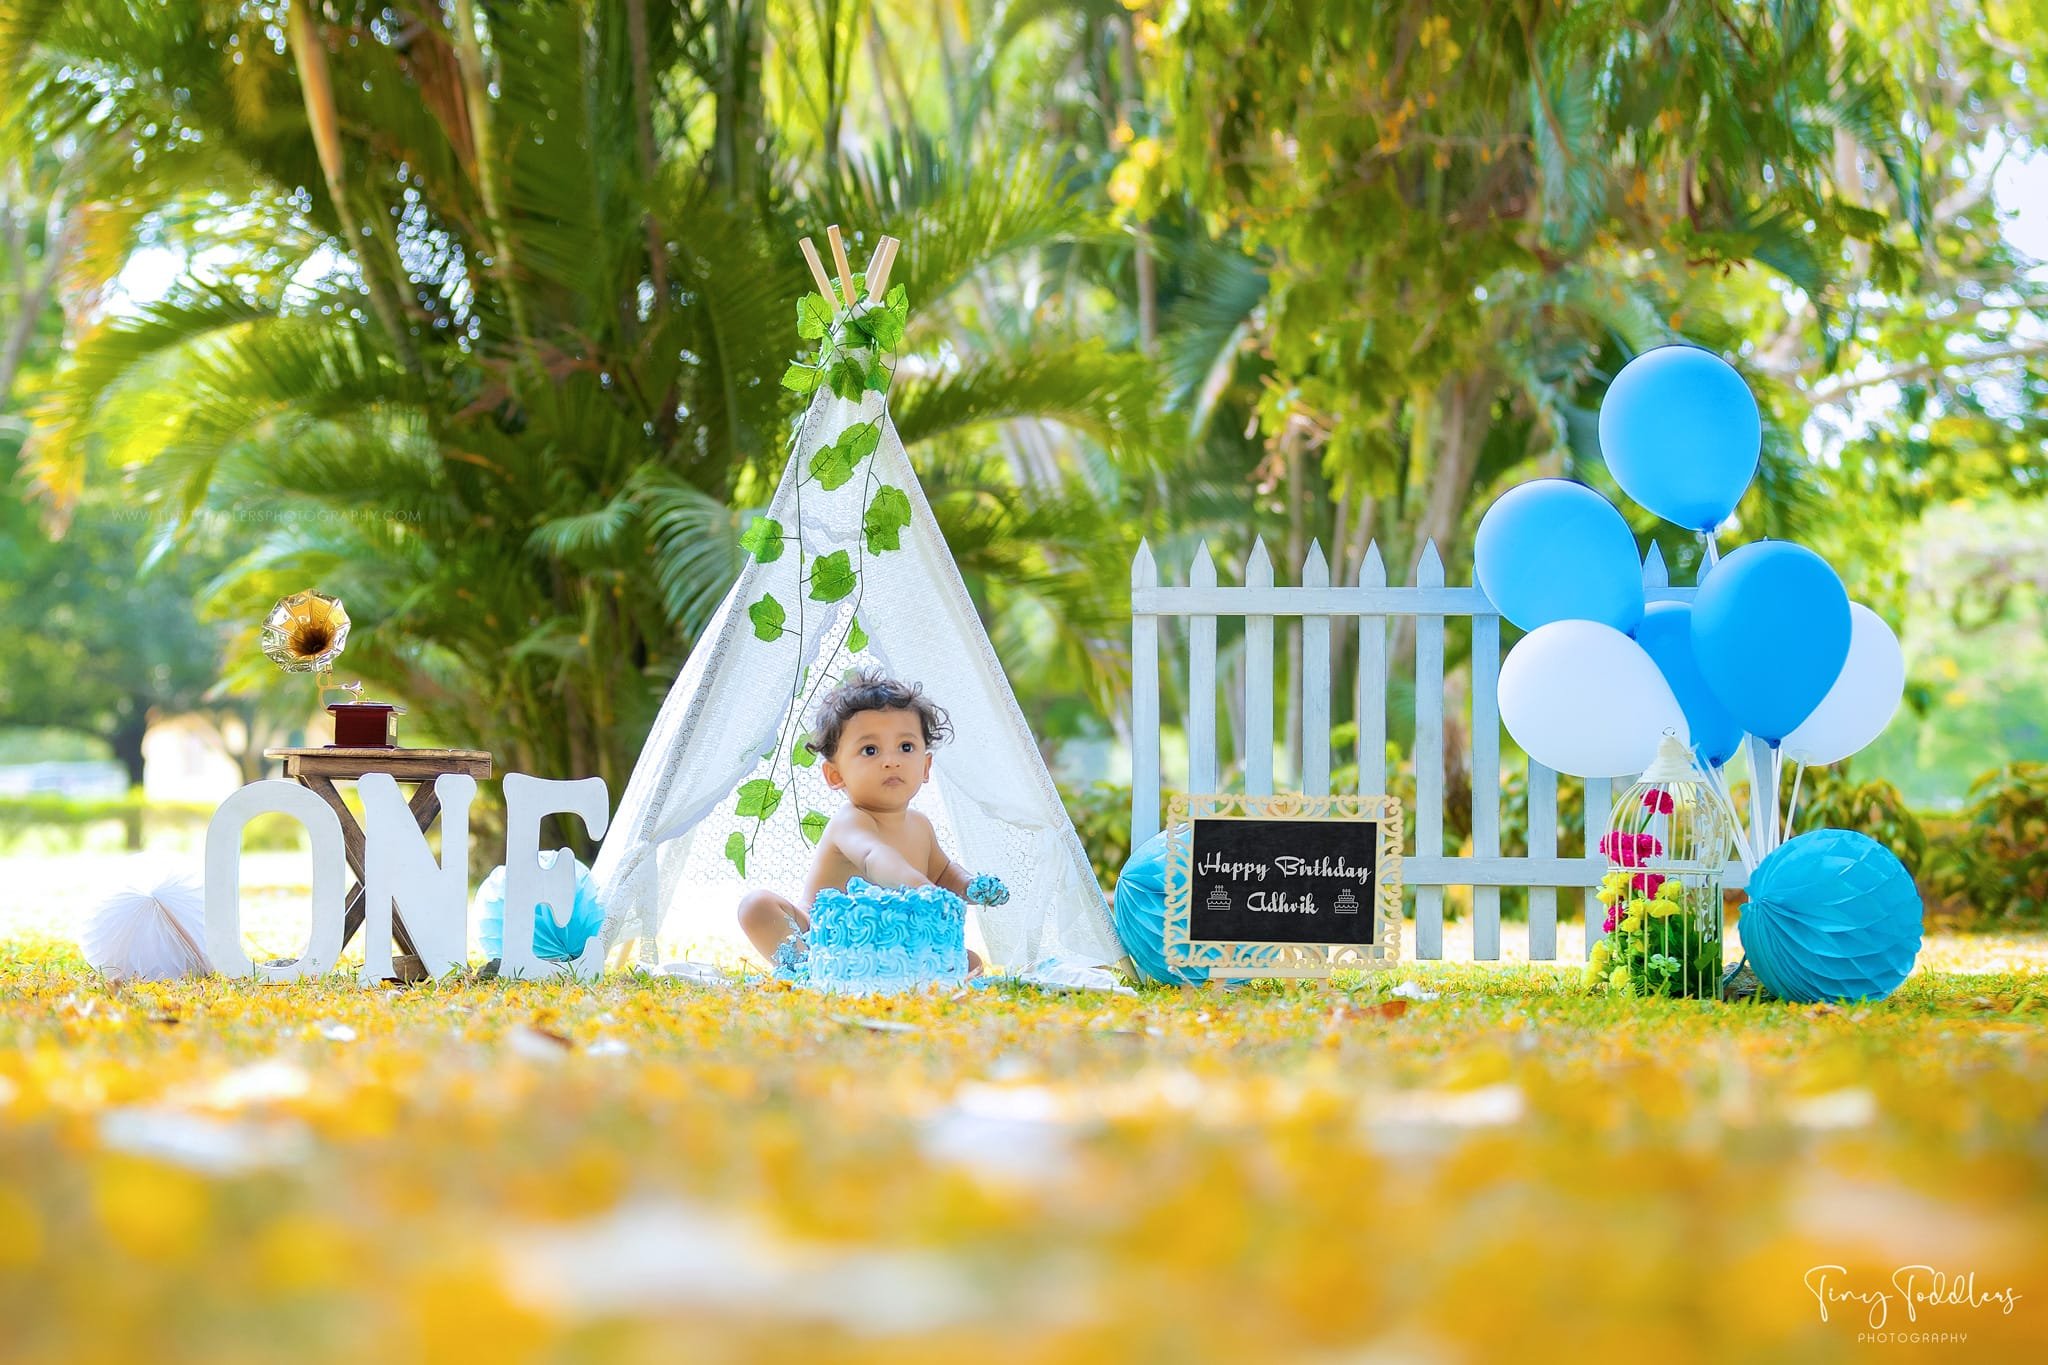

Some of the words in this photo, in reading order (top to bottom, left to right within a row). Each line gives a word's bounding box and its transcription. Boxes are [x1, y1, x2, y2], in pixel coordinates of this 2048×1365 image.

[205, 772, 610, 985] ONE
[1198, 852, 1271, 882] Happy
[1274, 855, 1372, 885] Birthday
[1246, 891, 1319, 915] Adhvik
